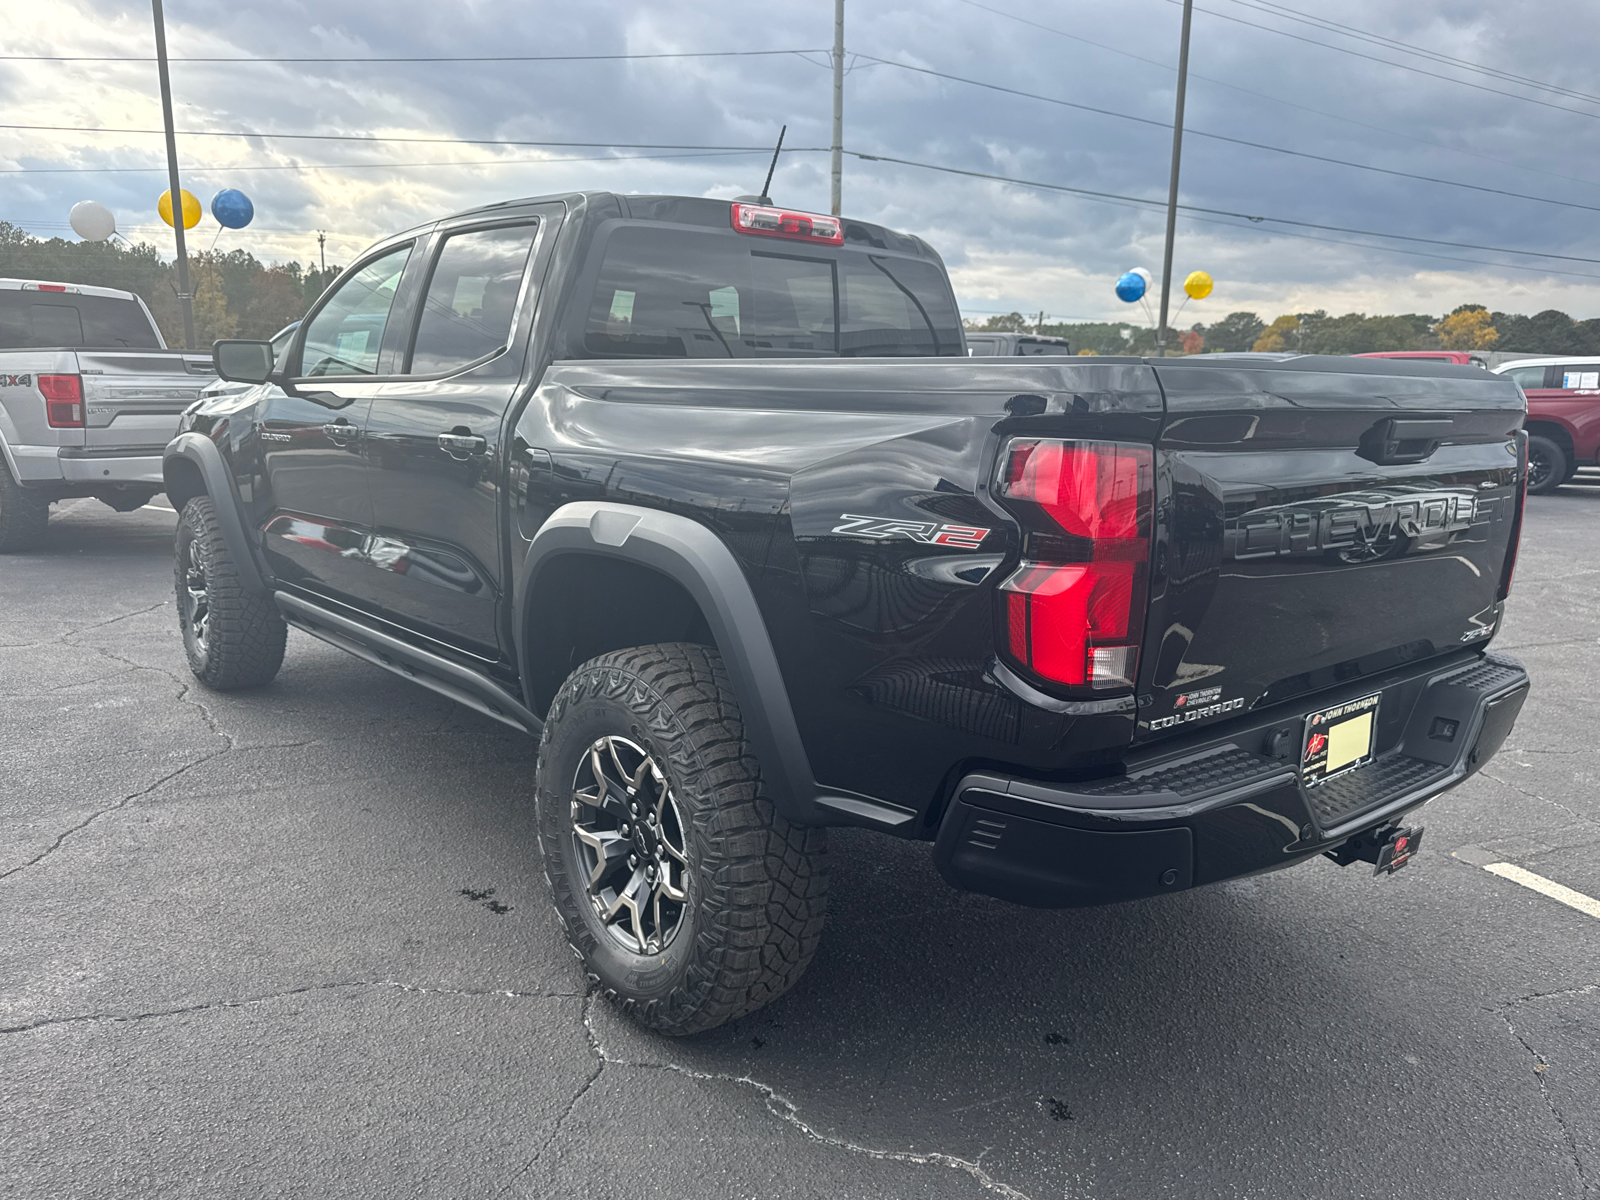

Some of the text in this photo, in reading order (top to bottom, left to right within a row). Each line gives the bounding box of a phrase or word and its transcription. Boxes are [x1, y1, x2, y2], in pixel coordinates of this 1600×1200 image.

[831, 513, 991, 550] ZR2
[1234, 489, 1512, 560] CHEVROLET
[1149, 697, 1244, 731] COLORADO
[1325, 706, 1343, 720] JOHN
[544, 789, 600, 958] WRANGLER
